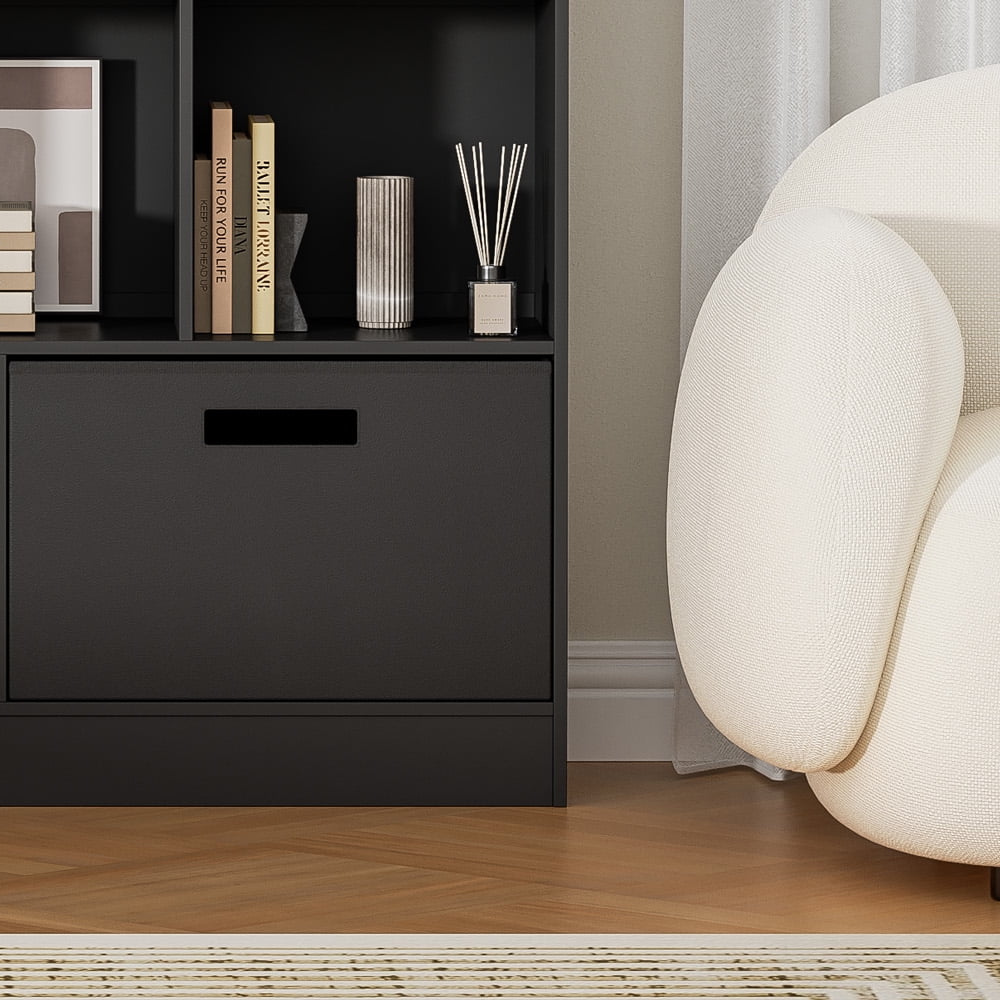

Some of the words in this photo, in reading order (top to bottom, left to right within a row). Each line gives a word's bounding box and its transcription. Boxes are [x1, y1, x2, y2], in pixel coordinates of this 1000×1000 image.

[216, 158, 226, 183] RUN
[257, 161, 270, 215] BALLET
[200, 200, 208, 223] KEEP
[216, 189, 226, 214] FOR
[200, 225, 208, 250] YOUR
[216, 219, 226, 253] YOUR
[234, 216, 248, 255] DIANA
[200, 252, 208, 277] HEAD
[257, 222, 270, 291] LORRAINE
[216, 259, 227, 283] LIFE
[200, 278, 208, 292] UP
